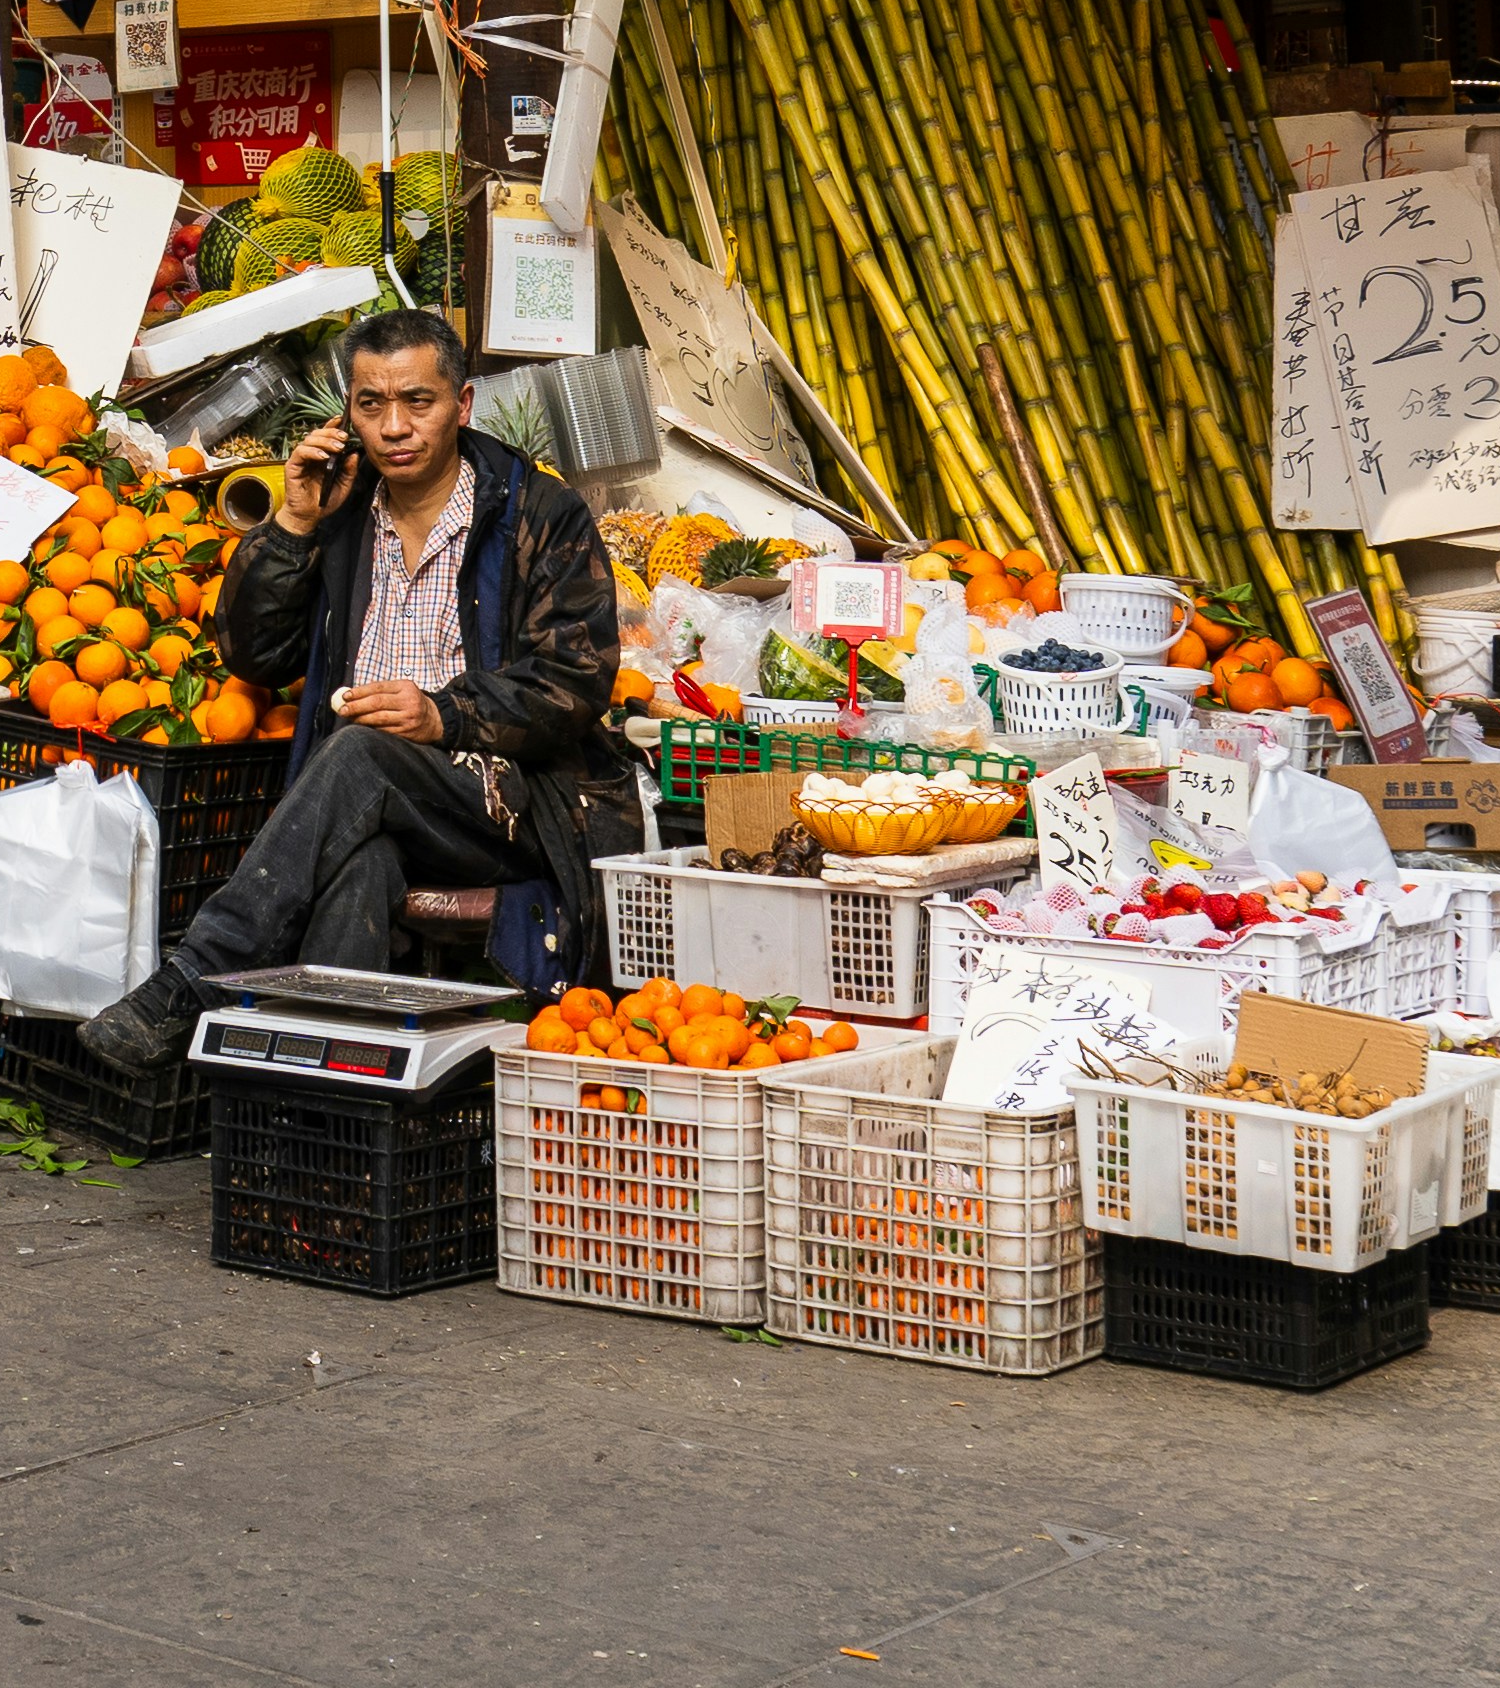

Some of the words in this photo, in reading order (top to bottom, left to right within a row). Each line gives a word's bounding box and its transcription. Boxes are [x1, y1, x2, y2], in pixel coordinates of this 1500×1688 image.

[123, 0, 171, 17] 扫我付款
[186, 63, 318, 105] 重庆农商行
[206, 103, 300, 141] 积分可用
[1384, 780, 1456, 798] 新鲜蓝莓
